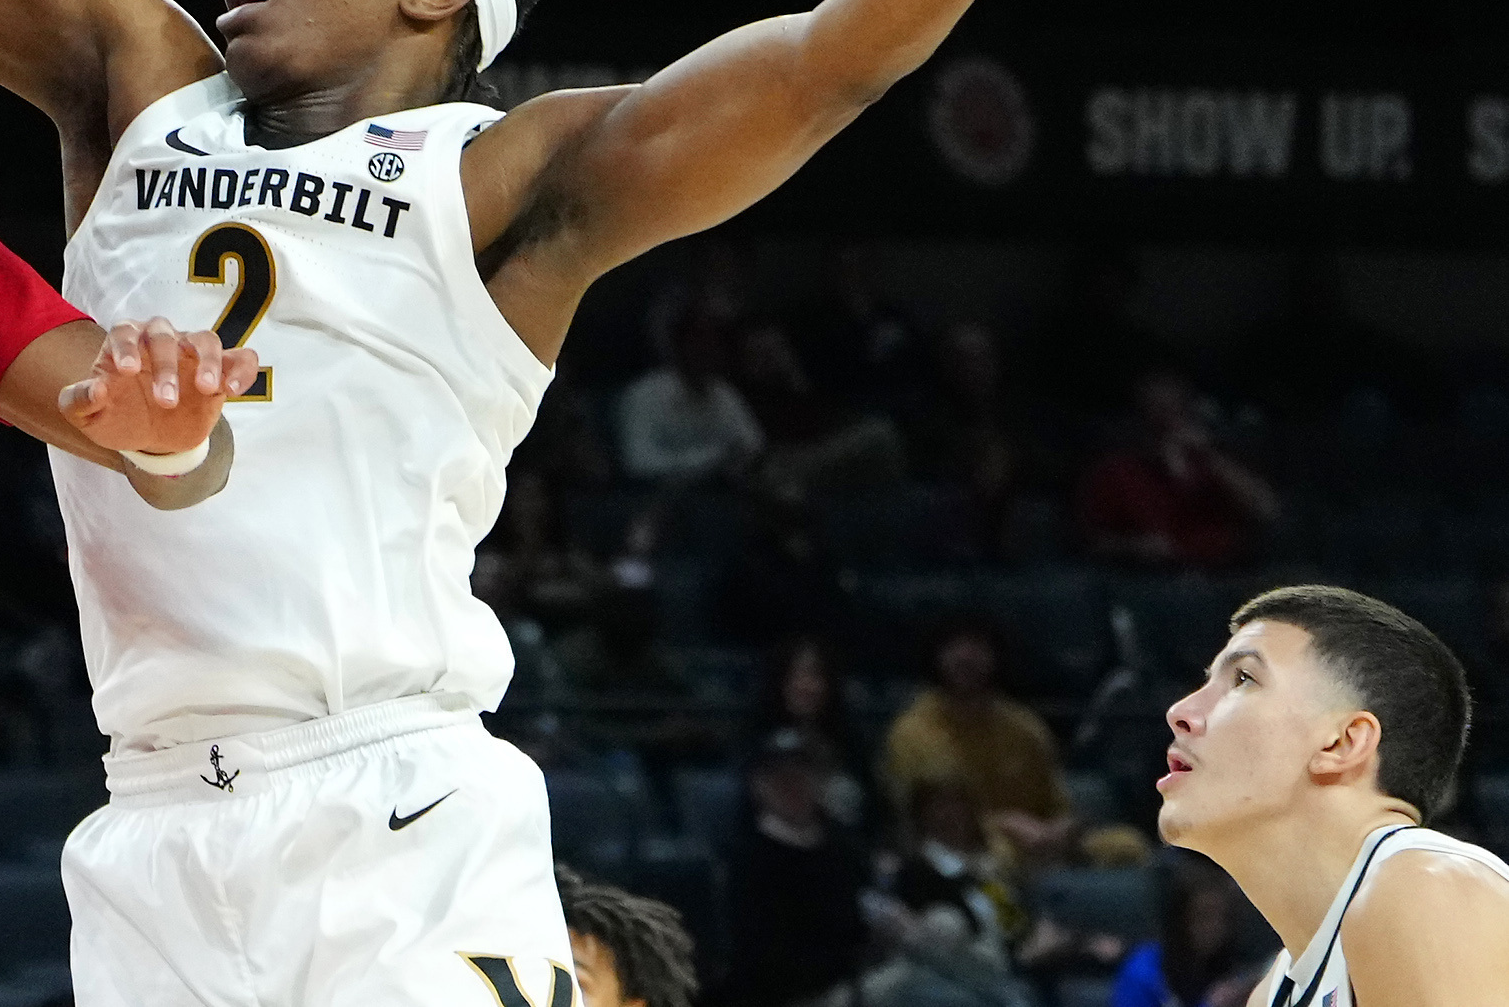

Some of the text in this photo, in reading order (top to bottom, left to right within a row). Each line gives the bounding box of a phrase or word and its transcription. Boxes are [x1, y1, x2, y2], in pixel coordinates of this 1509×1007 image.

[369, 153, 404, 181] SEC
[1088, 87, 1296, 178] SHOW
[135, 167, 411, 239] VANDERBILT
[187, 221, 277, 402] 2
